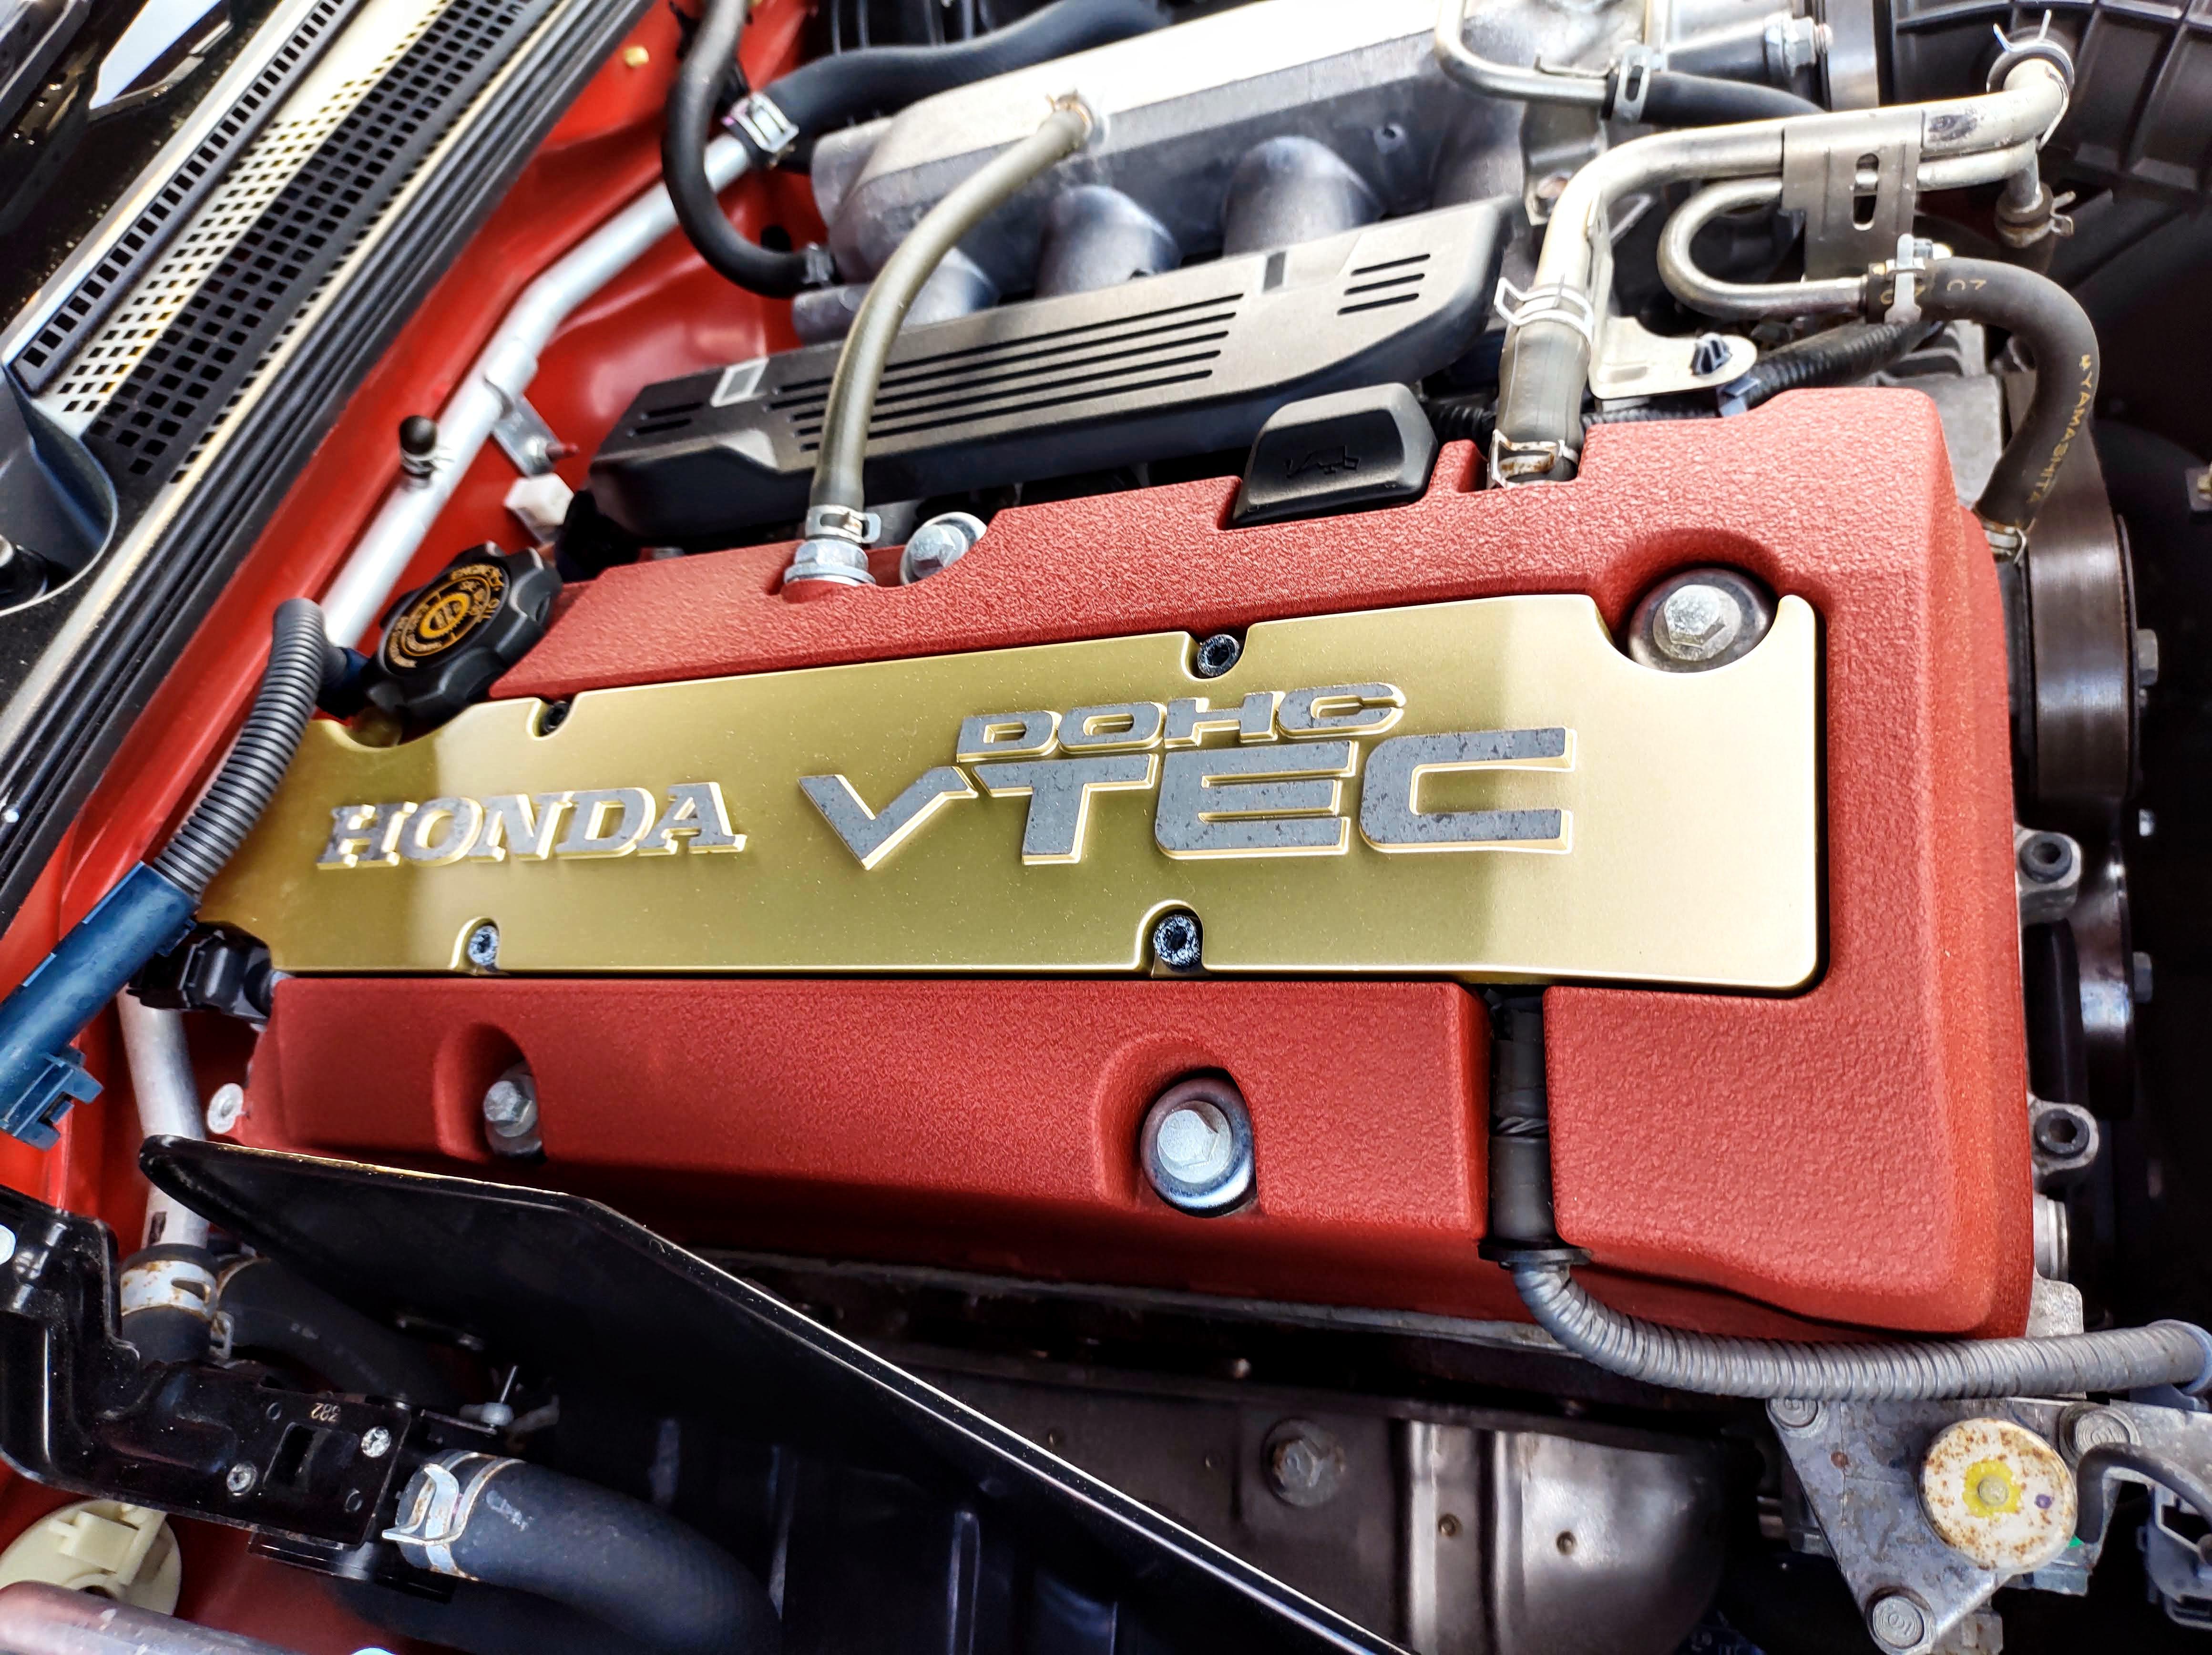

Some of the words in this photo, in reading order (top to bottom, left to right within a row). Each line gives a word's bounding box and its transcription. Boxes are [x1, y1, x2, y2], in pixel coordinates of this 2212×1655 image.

[957, 682, 1405, 763] DOHC
[317, 781, 748, 870] HONDA
[798, 726, 1577, 870] VTEC
